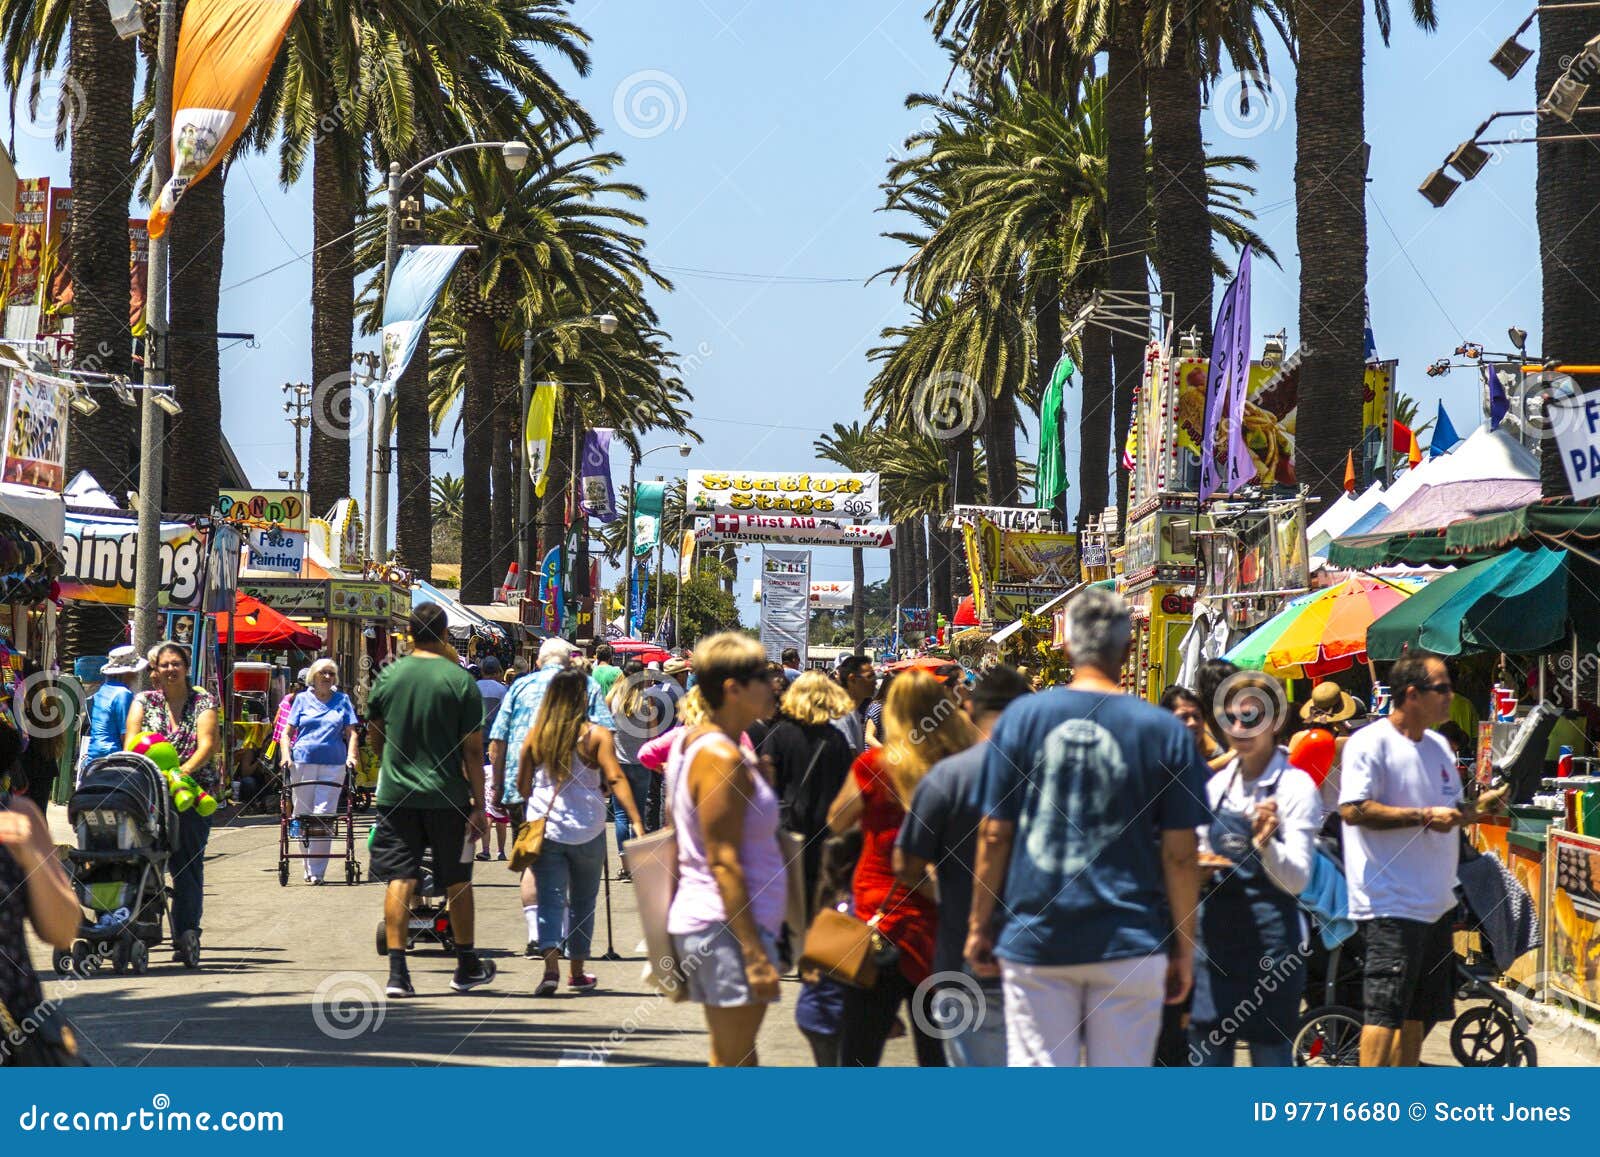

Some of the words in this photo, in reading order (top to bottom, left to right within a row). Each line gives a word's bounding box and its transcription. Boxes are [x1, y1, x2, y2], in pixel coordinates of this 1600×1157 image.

[700, 472, 864, 494] Station
[220, 496, 296, 520] CANDY
[729, 492, 835, 515] Stage
[844, 500, 872, 513] 805
[747, 516, 785, 529] First
[790, 516, 816, 529] Aid
[259, 531, 294, 548] Face
[798, 537, 837, 546] Childrens
[839, 538, 879, 547] Barnyard
[63, 527, 200, 602] aintng
[248, 552, 301, 571] Painting
